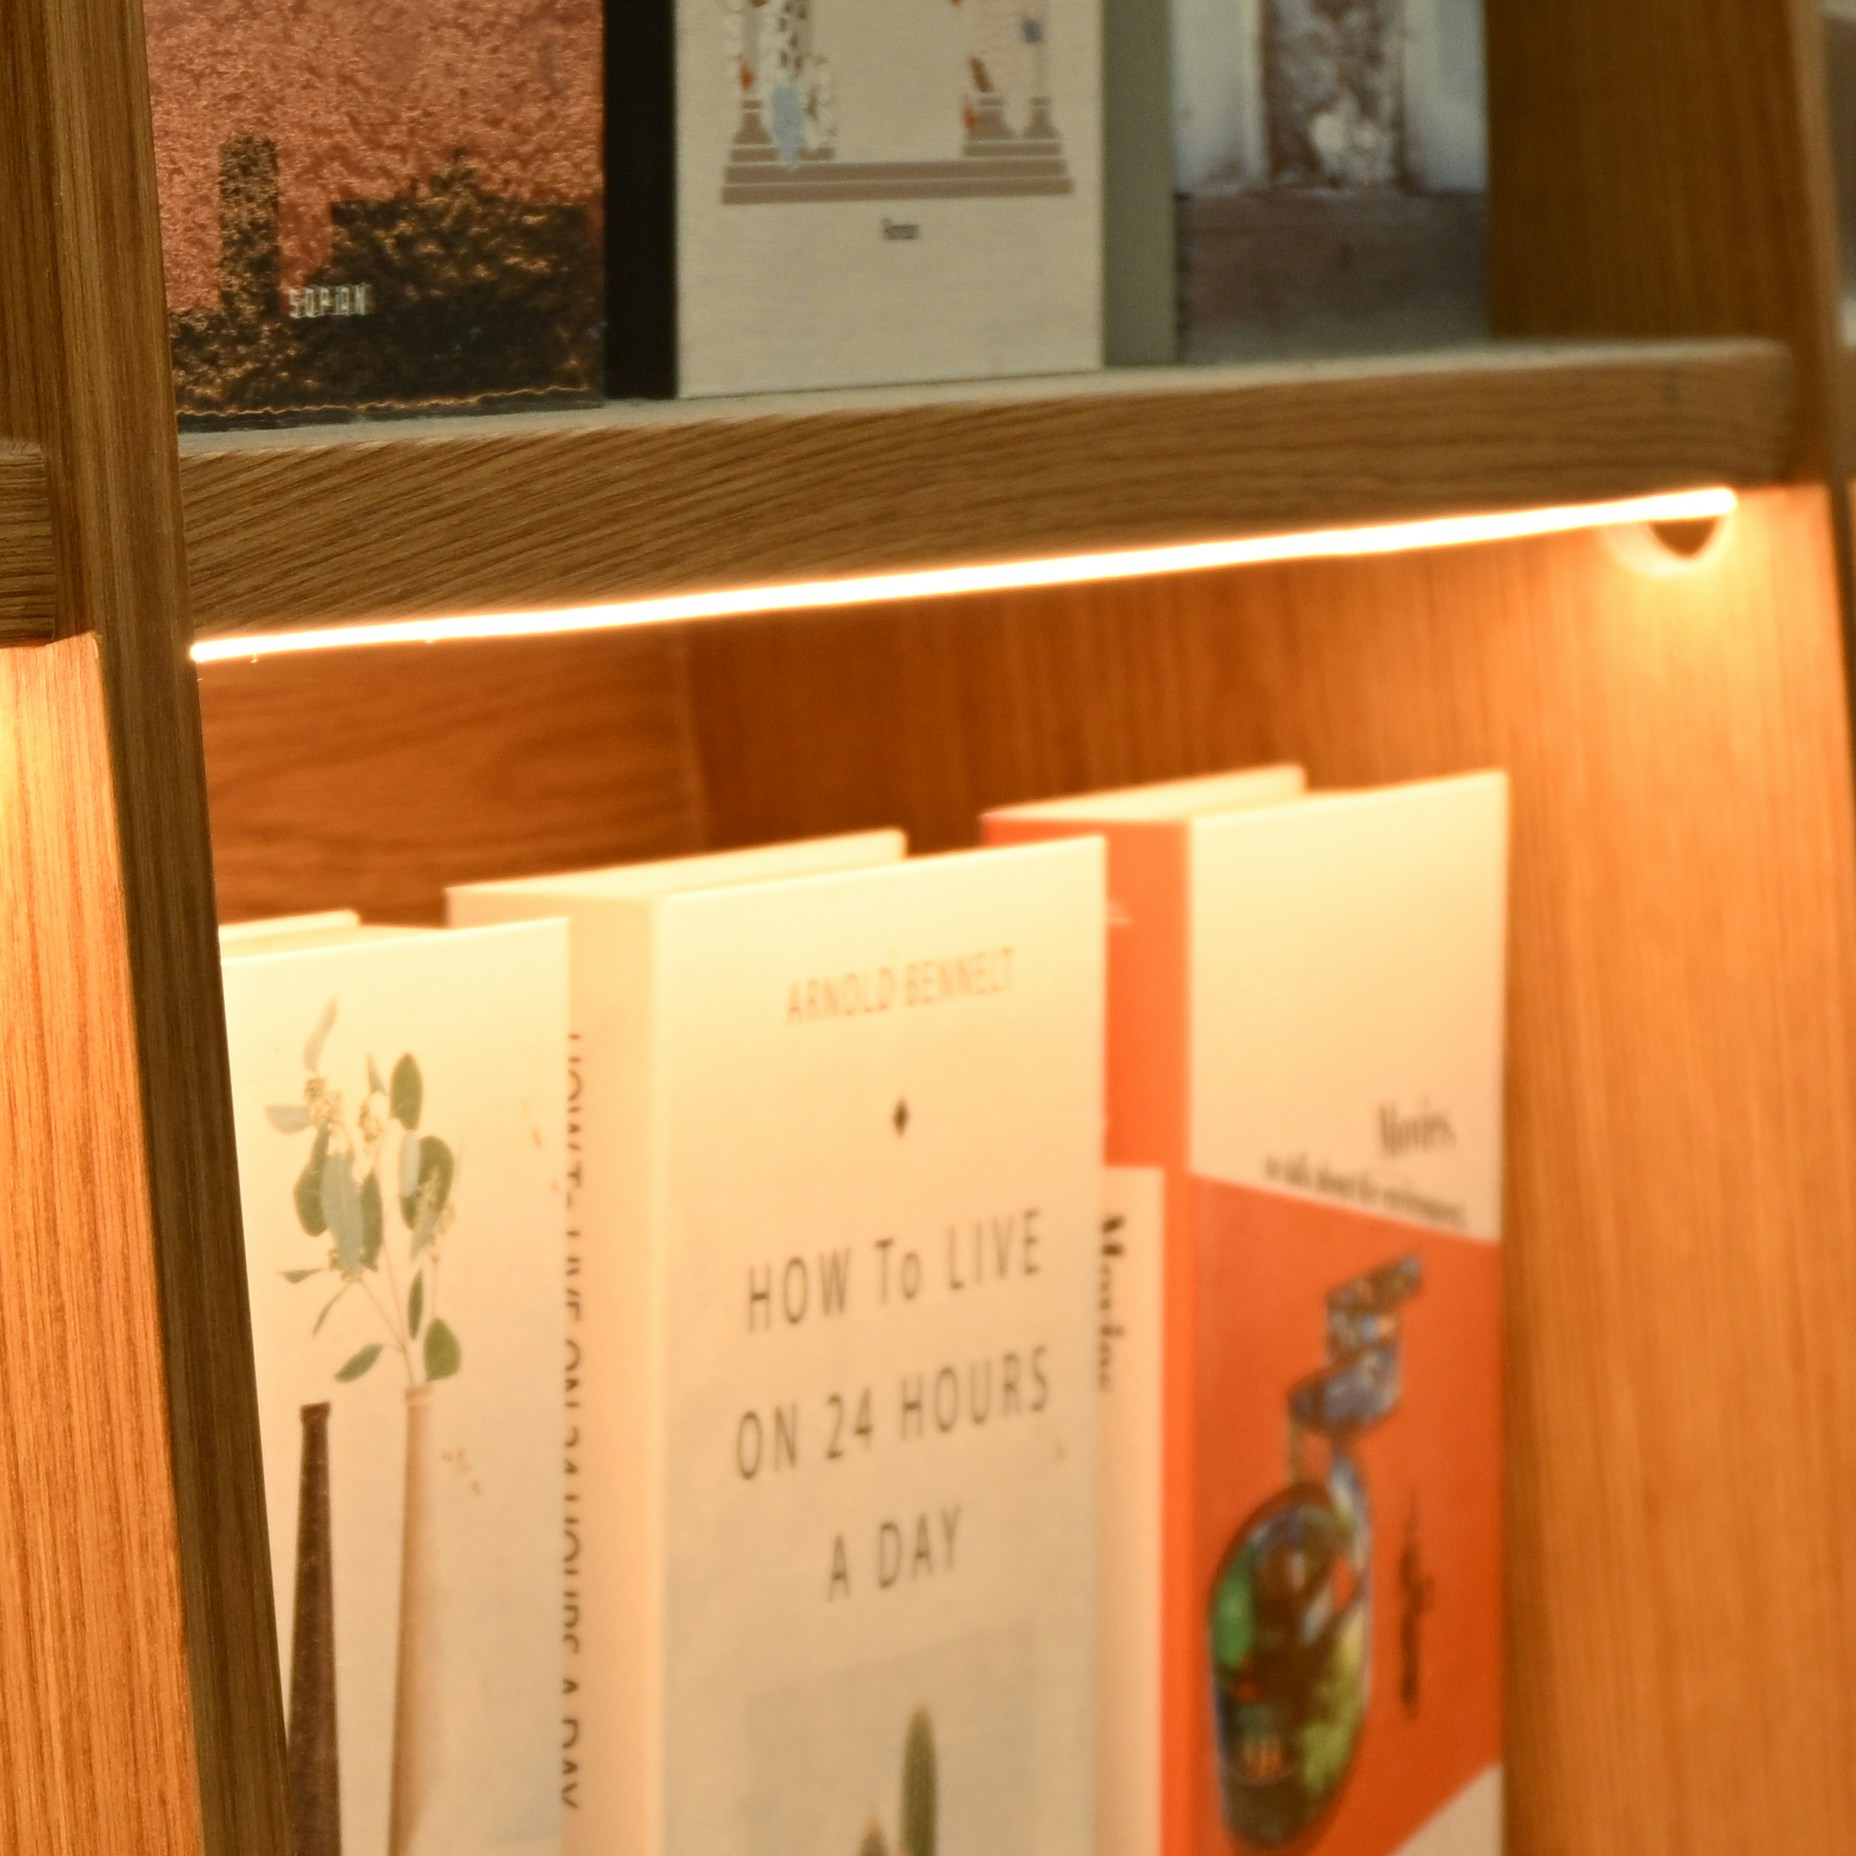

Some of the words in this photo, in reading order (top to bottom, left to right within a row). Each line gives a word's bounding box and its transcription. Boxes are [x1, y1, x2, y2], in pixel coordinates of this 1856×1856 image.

[786, 967, 896, 1024] ARNOLD
[748, 1247, 851, 1332] HOW
[875, 1237, 922, 1305] To
[947, 1208, 1042, 1291] LIVE
[736, 1403, 799, 1479] ON
[825, 1389, 874, 1461] 24
[900, 1346, 1049, 1442] HOURS
[828, 1535, 850, 1600] A
[878, 1505, 961, 1589] DAY
